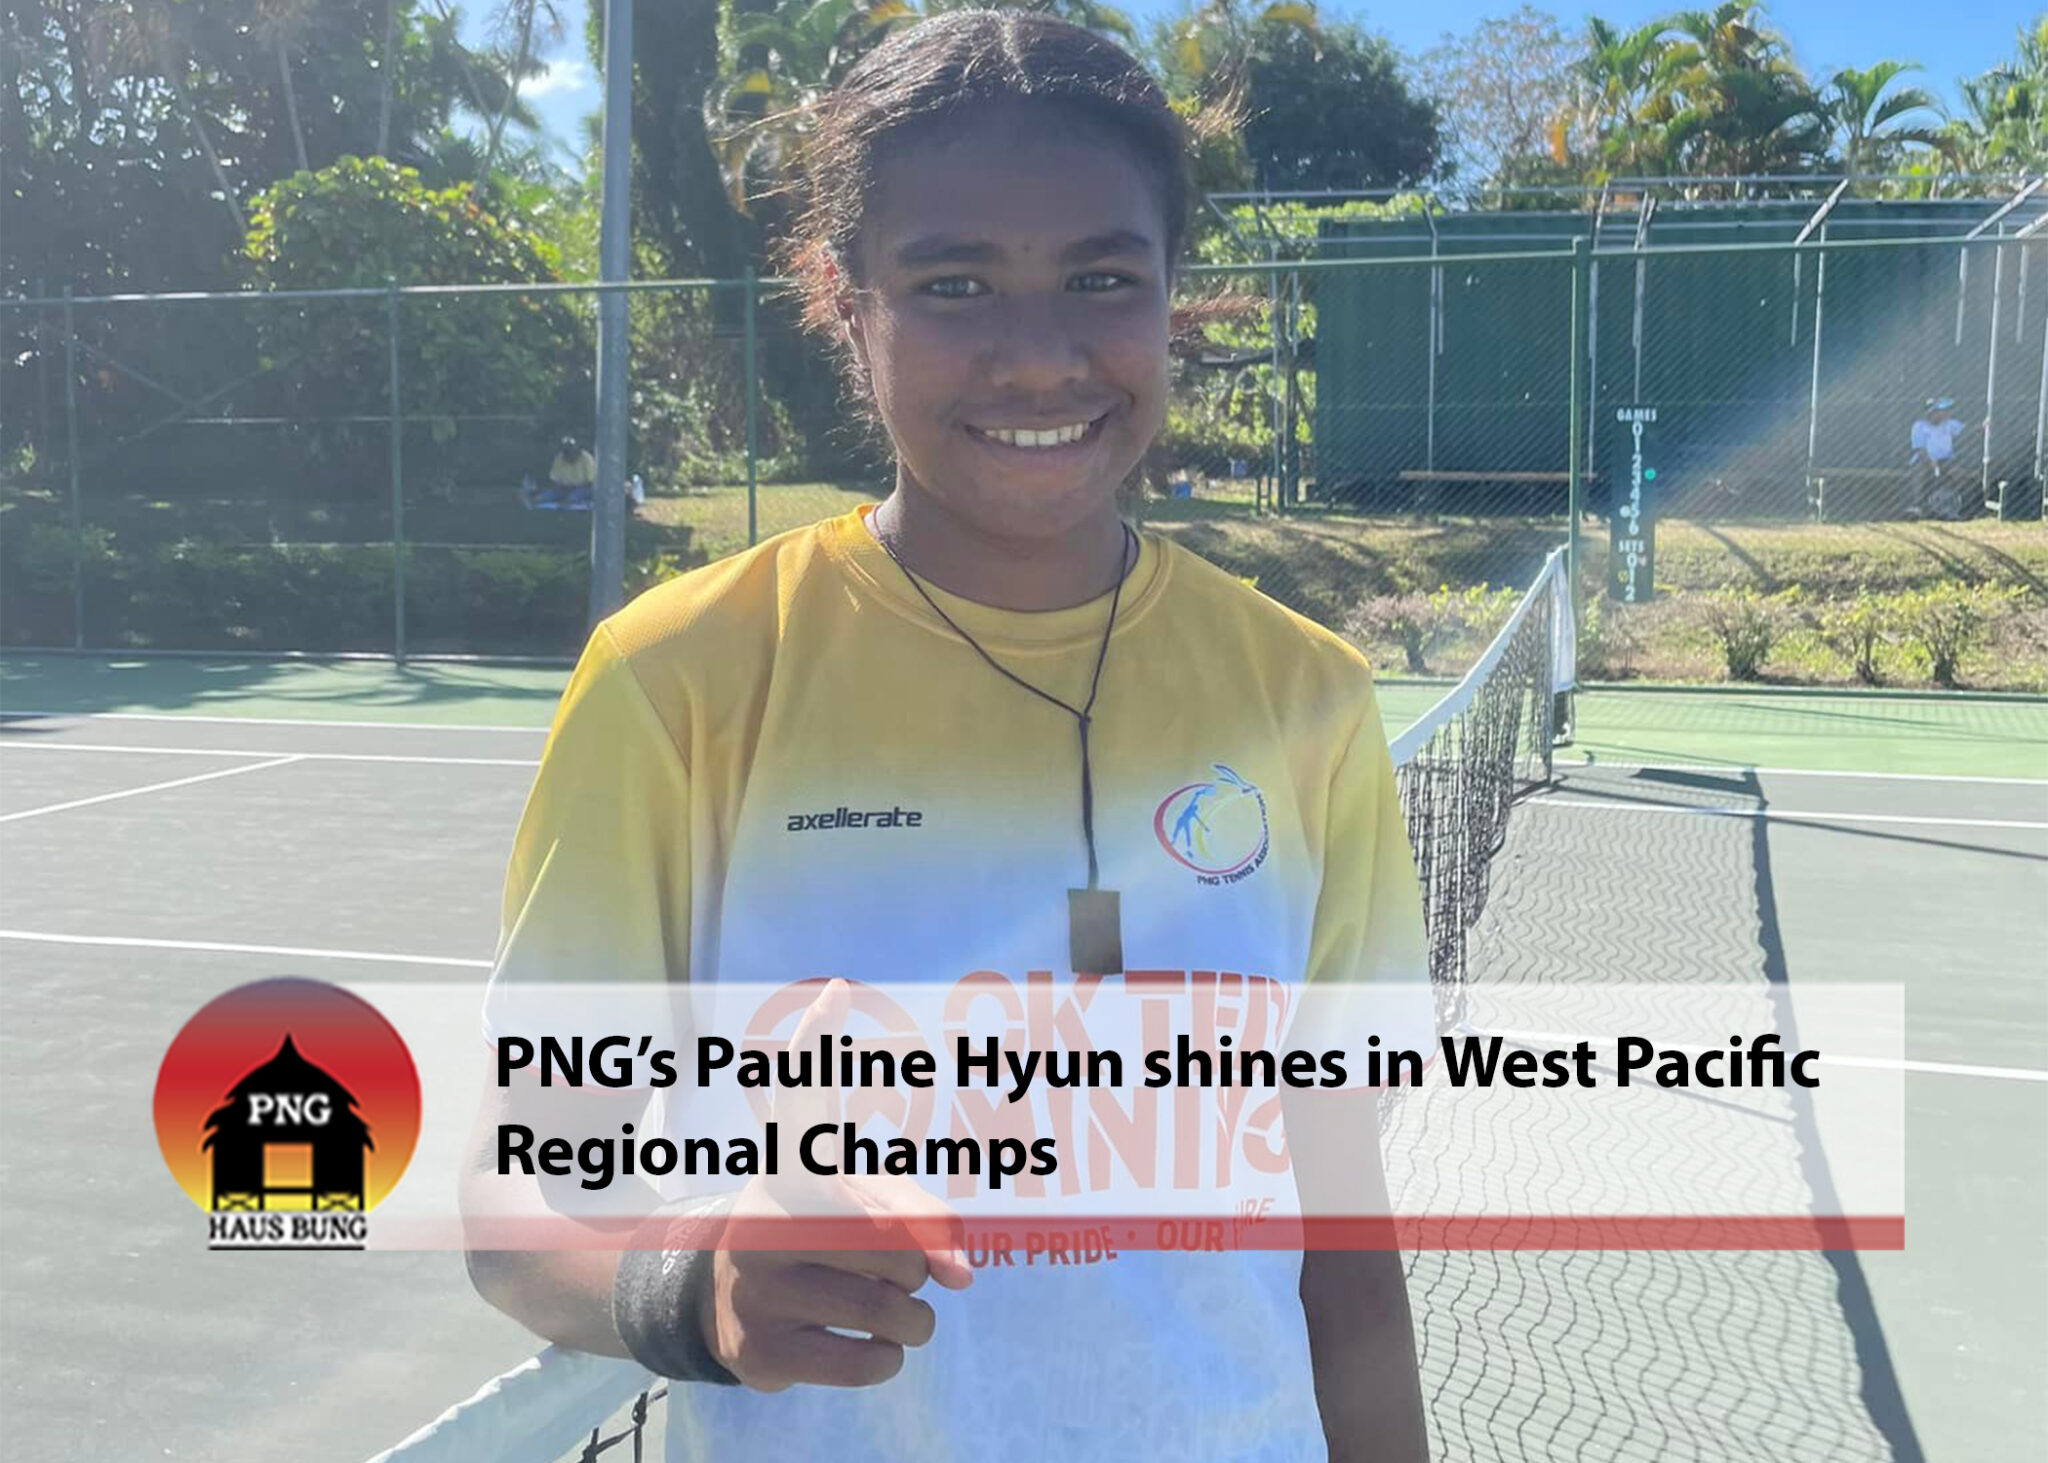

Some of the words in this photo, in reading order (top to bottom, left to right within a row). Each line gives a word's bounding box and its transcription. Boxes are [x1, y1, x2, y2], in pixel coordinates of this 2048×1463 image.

[1616, 408, 1657, 422] GAMES
[1632, 422, 1643, 437] 0
[1632, 453, 1642, 469] 2
[1632, 469, 1642, 486] 3
[1630, 487, 1641, 501] 4
[1629, 520, 1639, 536] 6
[1618, 540, 1645, 553] SETS
[1626, 552, 1637, 568] 0
[1625, 585, 1635, 601] 2
[787, 807, 923, 831] axellerate
[943, 968, 1107, 1078] OK
[966, 1231, 1015, 1268] UR
[1025, 1225, 1118, 1266] PRIDE
[1156, 1219, 1225, 1252] OUR
